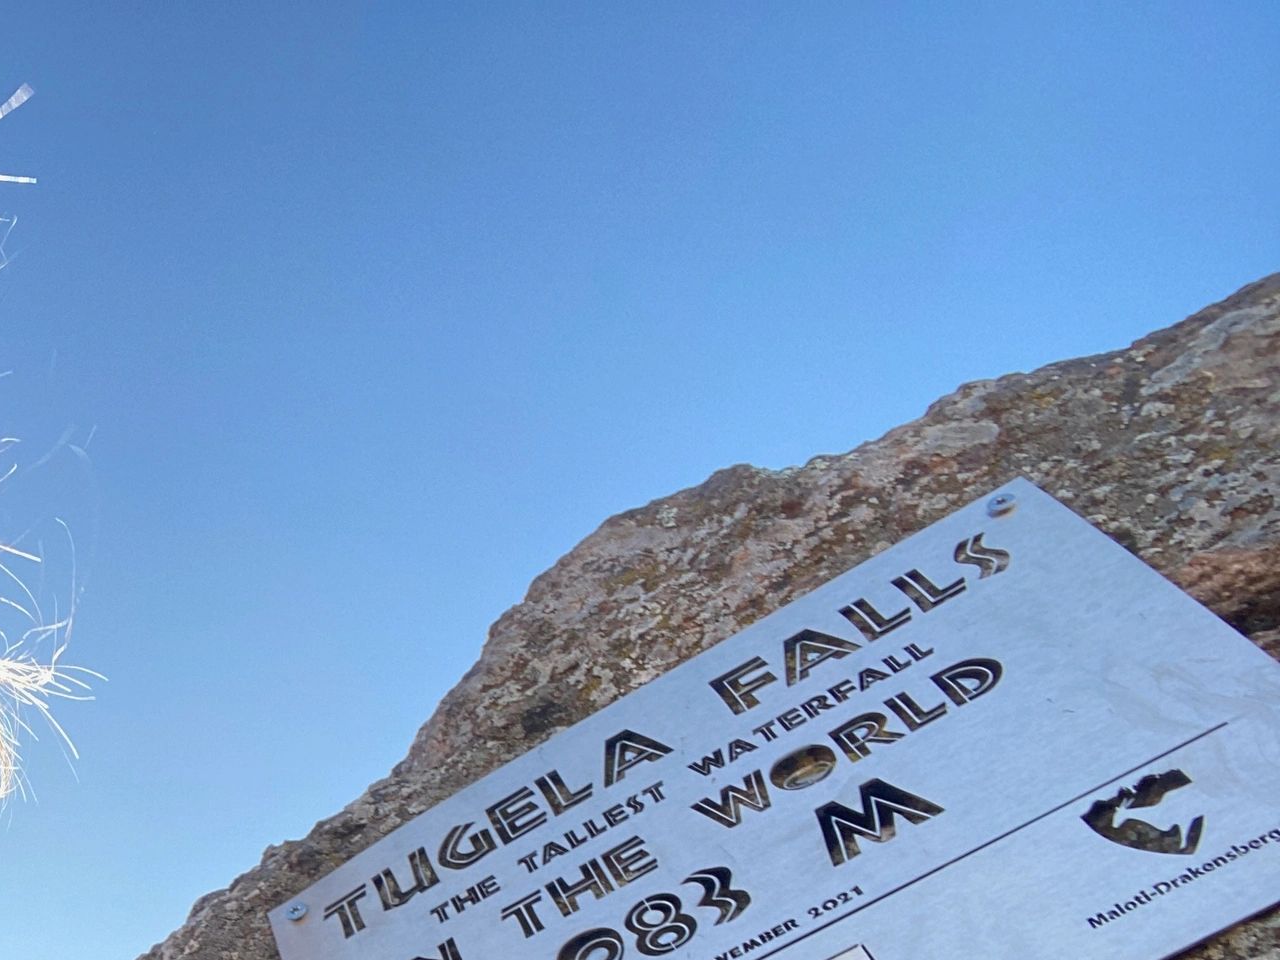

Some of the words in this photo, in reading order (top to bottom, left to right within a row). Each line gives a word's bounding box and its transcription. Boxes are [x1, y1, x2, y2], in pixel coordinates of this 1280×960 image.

[322, 728, 675, 940] TUGELA
[707, 531, 1011, 716] FALLS
[429, 874, 503, 924] THE
[516, 780, 667, 875] TALLEST
[686, 641, 935, 777] WATERFALL
[499, 834, 659, 940] THE
[689, 657, 1004, 829] WORLD
[814, 777, 946, 868] M
[807, 885, 864, 920] 2021
[1087, 828, 1280, 929] Maloti-Drakensberg
